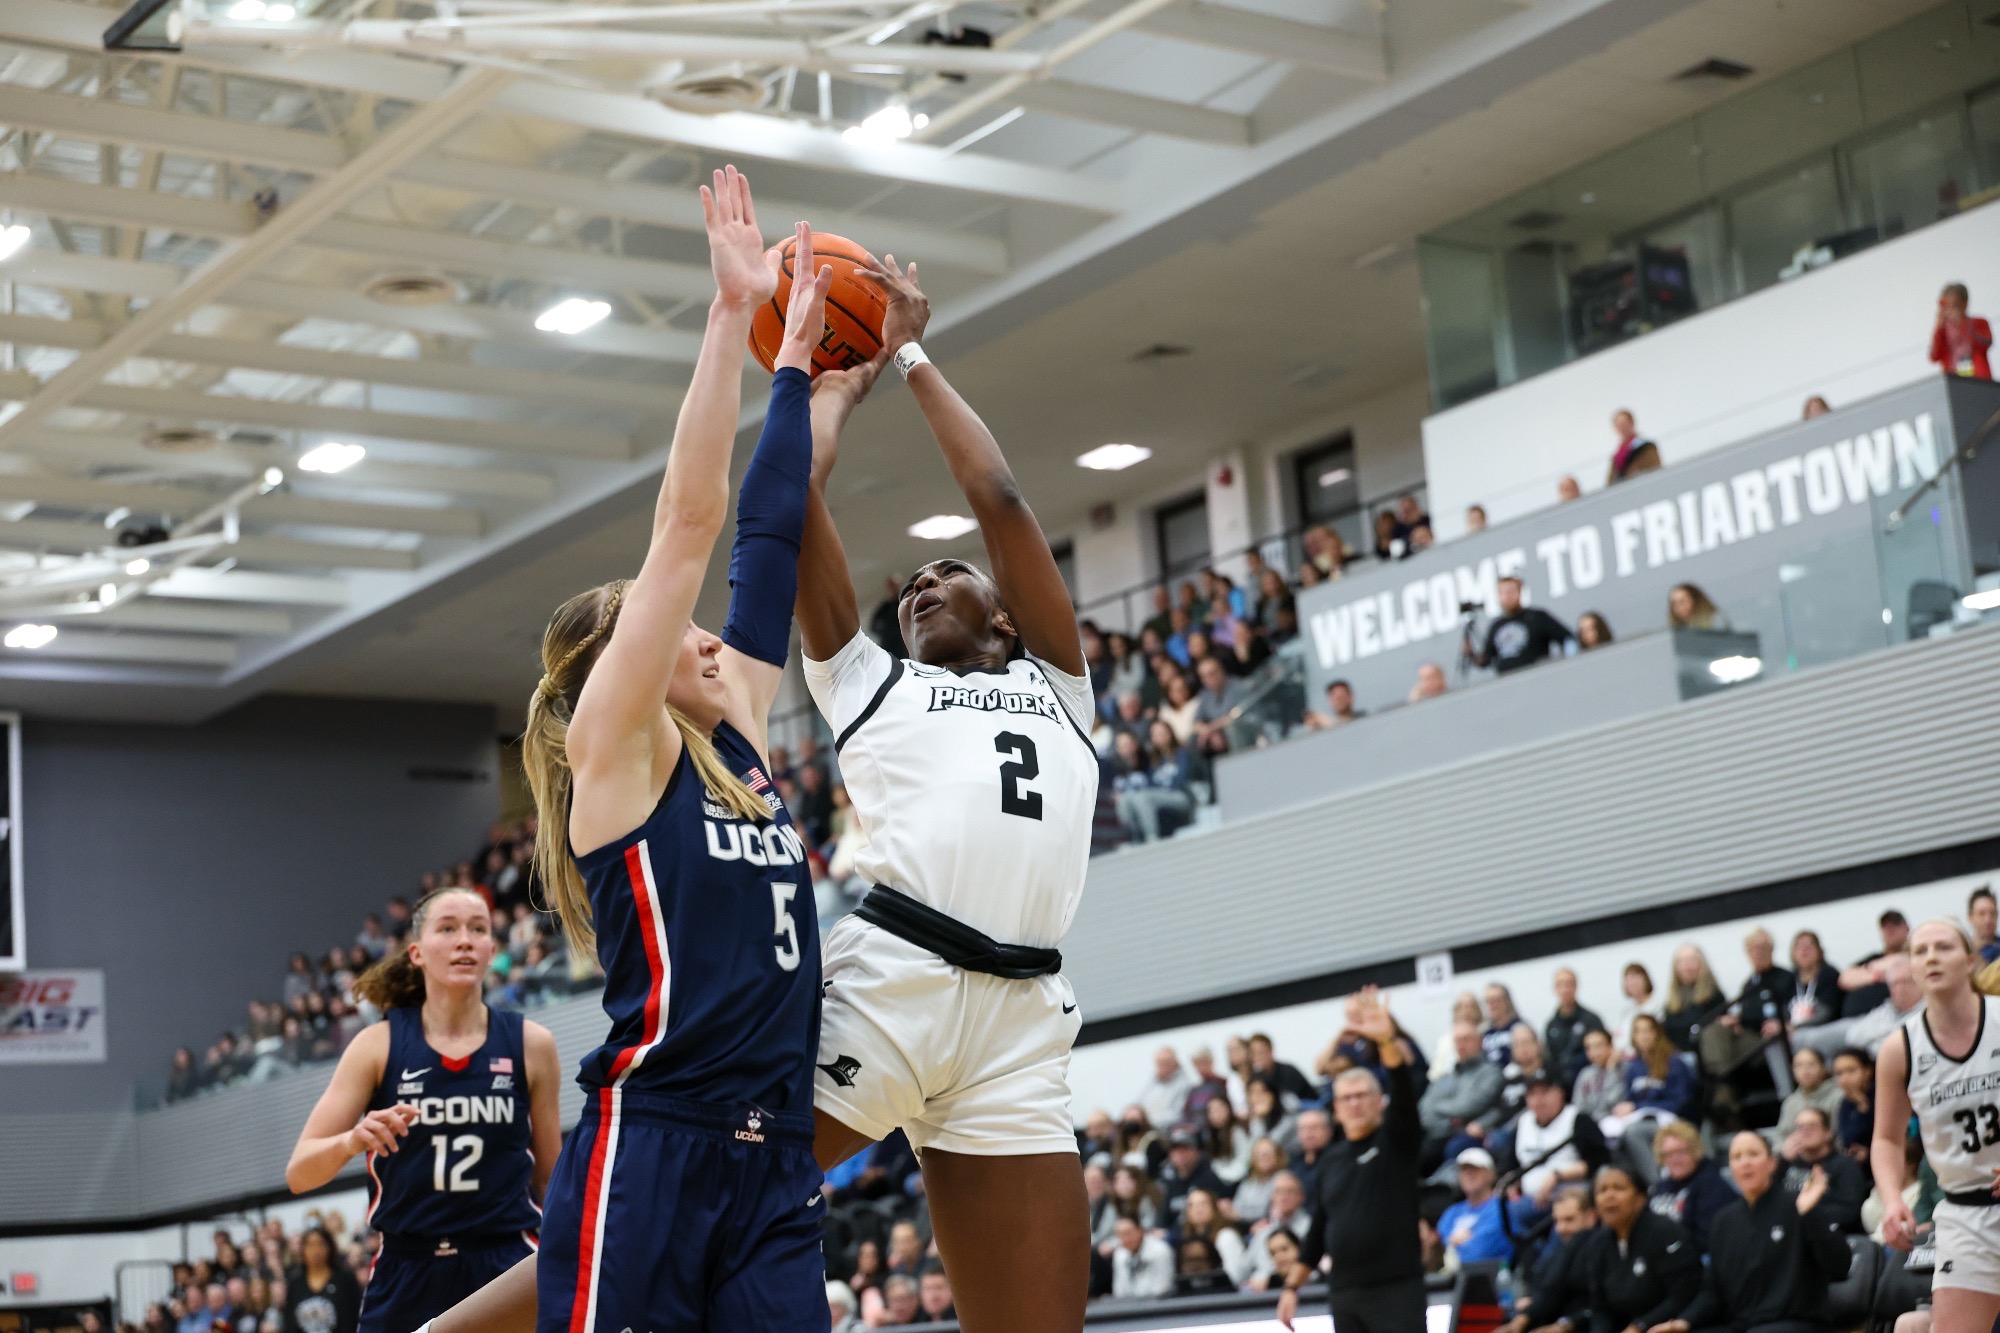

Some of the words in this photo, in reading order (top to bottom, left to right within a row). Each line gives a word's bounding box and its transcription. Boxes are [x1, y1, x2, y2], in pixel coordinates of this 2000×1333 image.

[1536, 523, 1602, 599] TO
[1610, 412, 1940, 580] FRIARTOWN
[927, 686, 1063, 725] PROVIDEN
[994, 730, 1043, 821] 2
[704, 820, 806, 867] UCON
[771, 882, 800, 972] 5
[3, 1006, 98, 1031] AST
[735, 1130, 765, 1143] UCONN
[1953, 1103, 2000, 1153] 33
[431, 1134, 484, 1192] 12
